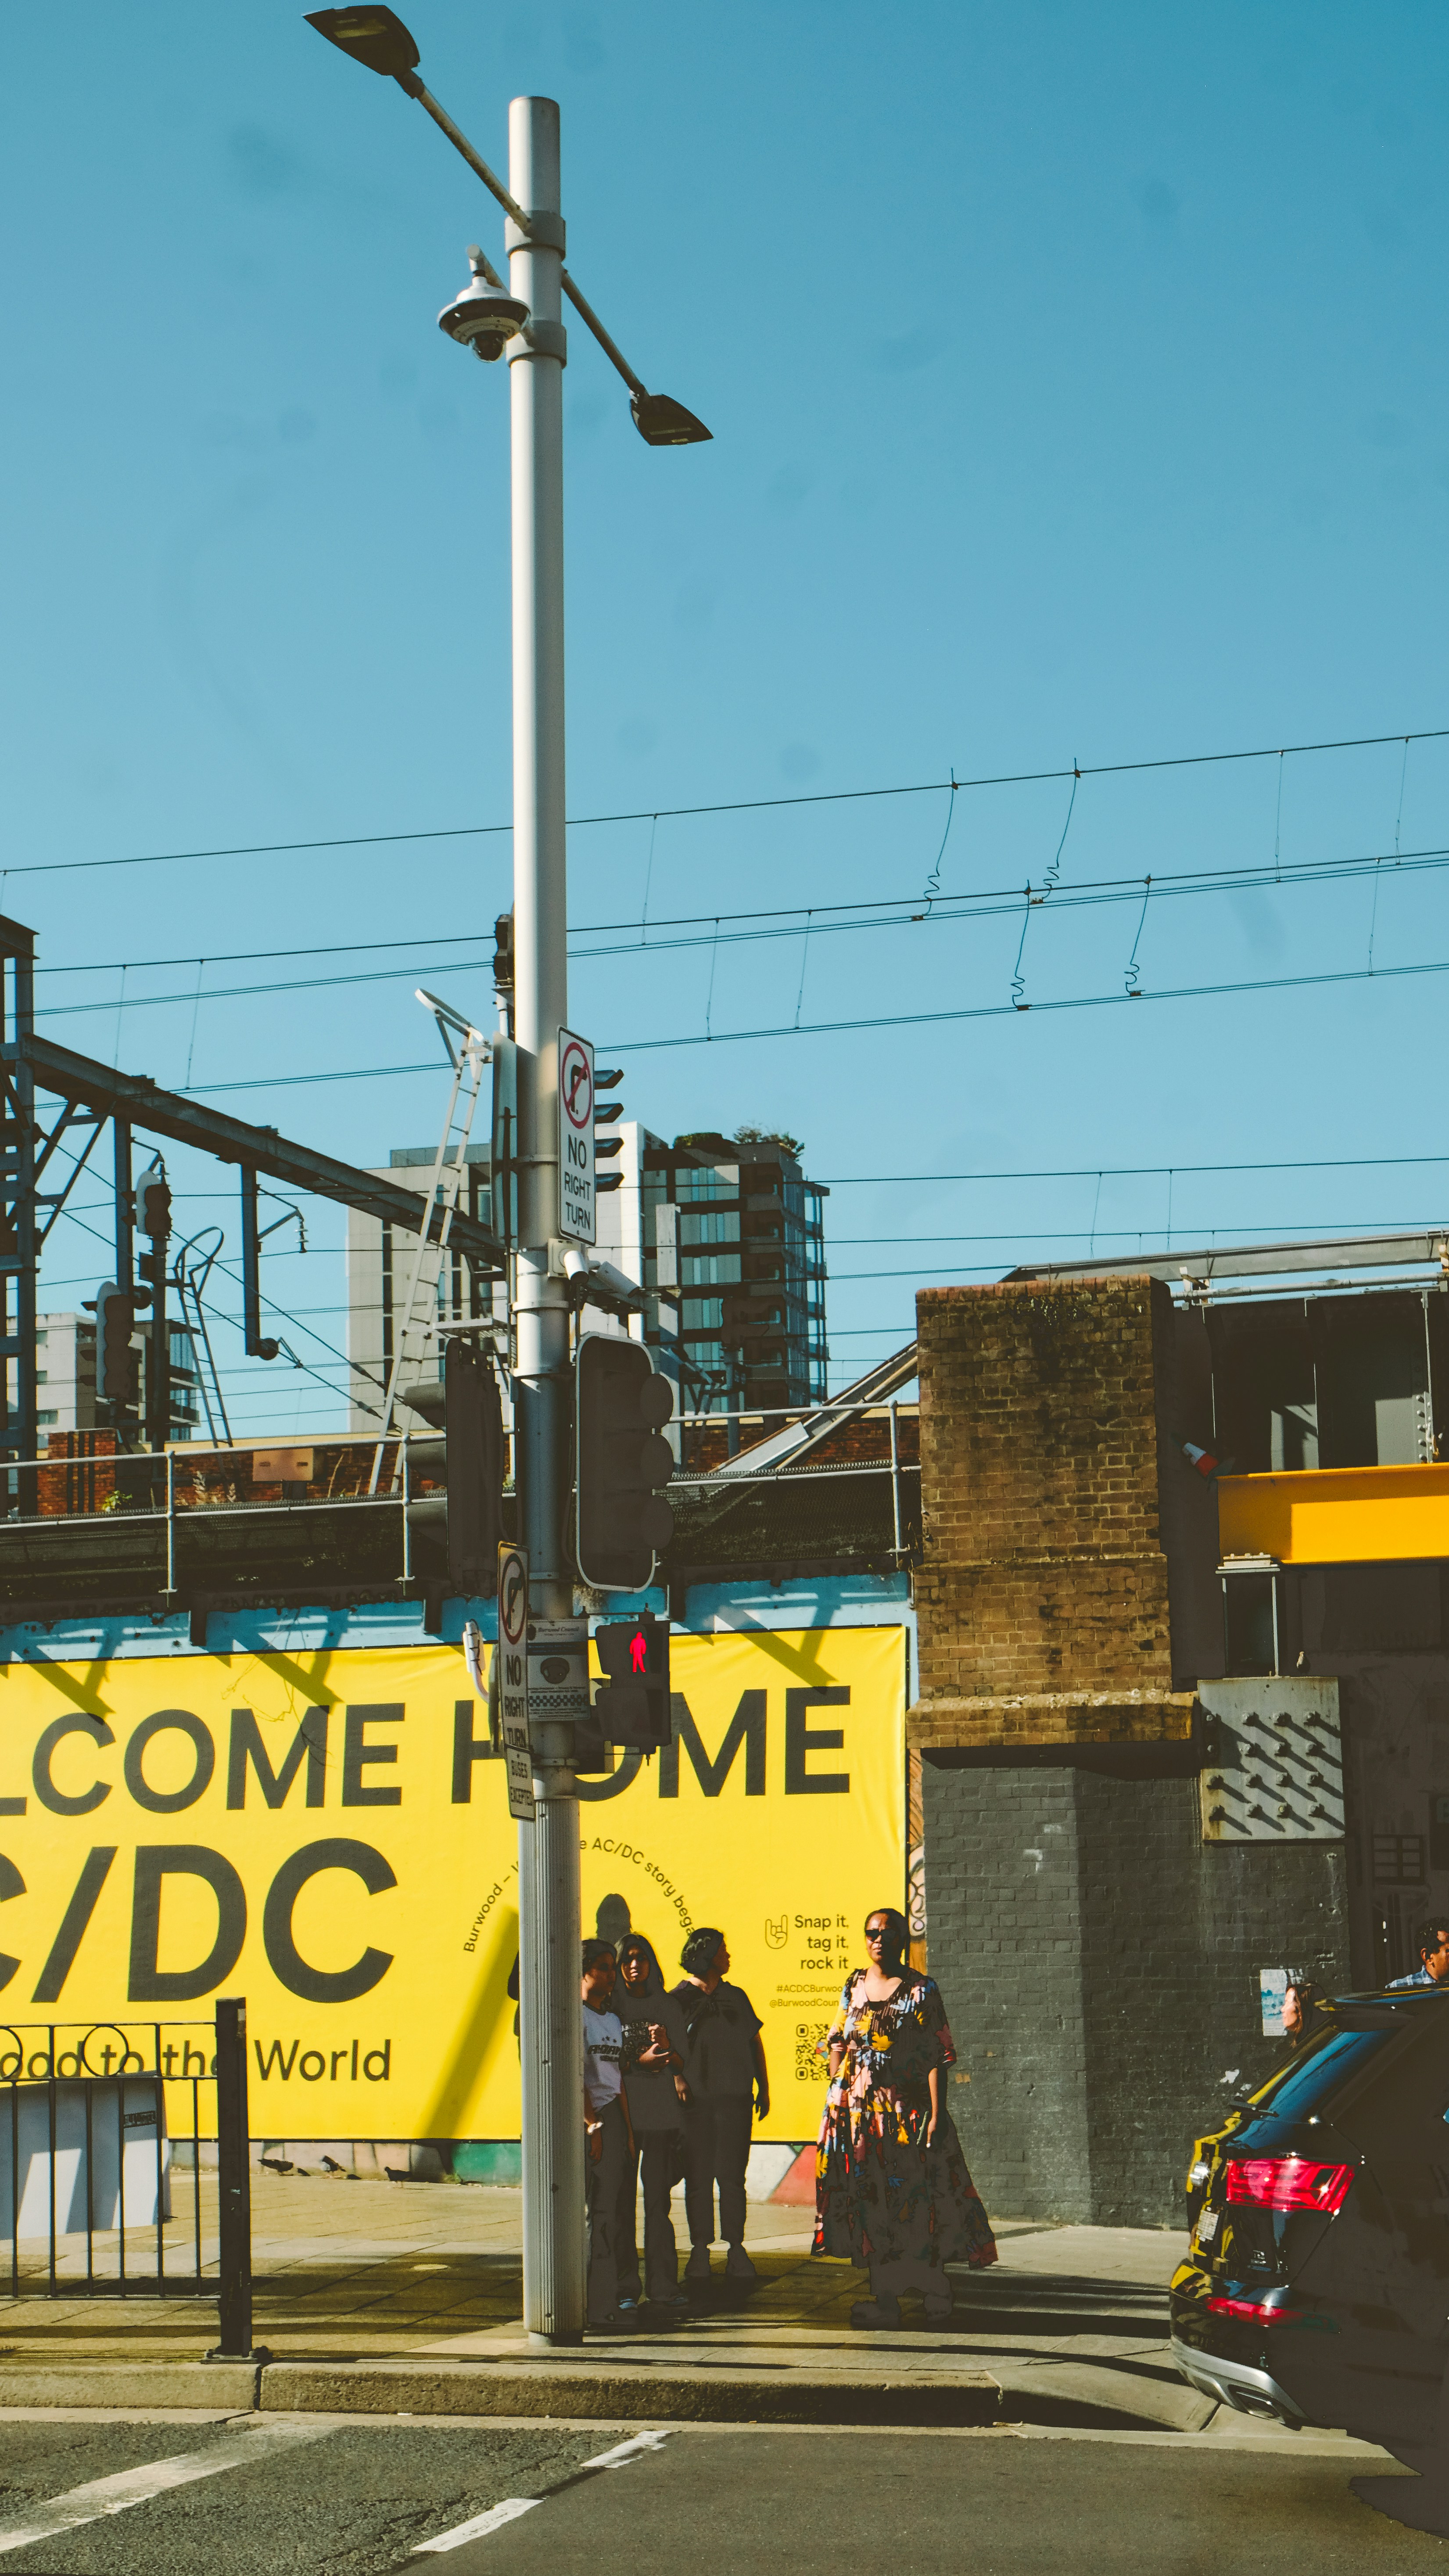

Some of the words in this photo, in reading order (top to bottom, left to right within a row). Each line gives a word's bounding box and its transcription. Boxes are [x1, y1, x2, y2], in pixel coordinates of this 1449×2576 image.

[568, 1134, 586, 1169] NO
[564, 1171, 591, 1200] RIGHT
[566, 1201, 590, 1230] TURN
[506, 1654, 521, 1686] NO
[505, 1696, 525, 1718] RIGHT
[507, 1727, 526, 1748] TURN
[0, 1703, 405, 1816] COME
[464, 1883, 503, 1952] Burwood
[592, 1837, 644, 1865] AC/DC
[644, 1862, 676, 1897] story
[673, 1894, 696, 1936] bega
[0, 1837, 398, 2003] /DC
[794, 1915, 831, 1931] Snap
[807, 1936, 831, 1952] tag
[800, 1956, 833, 1969] rock
[839, 1955, 849, 1969] it
[769, 1998, 839, 2008] @BurwoodCoun
[776, 1984, 843, 1993] #ACDCBurwoo
[100, 2044, 145, 2077] to
[162, 2040, 217, 2077] th
[254, 2039, 391, 2082] World
